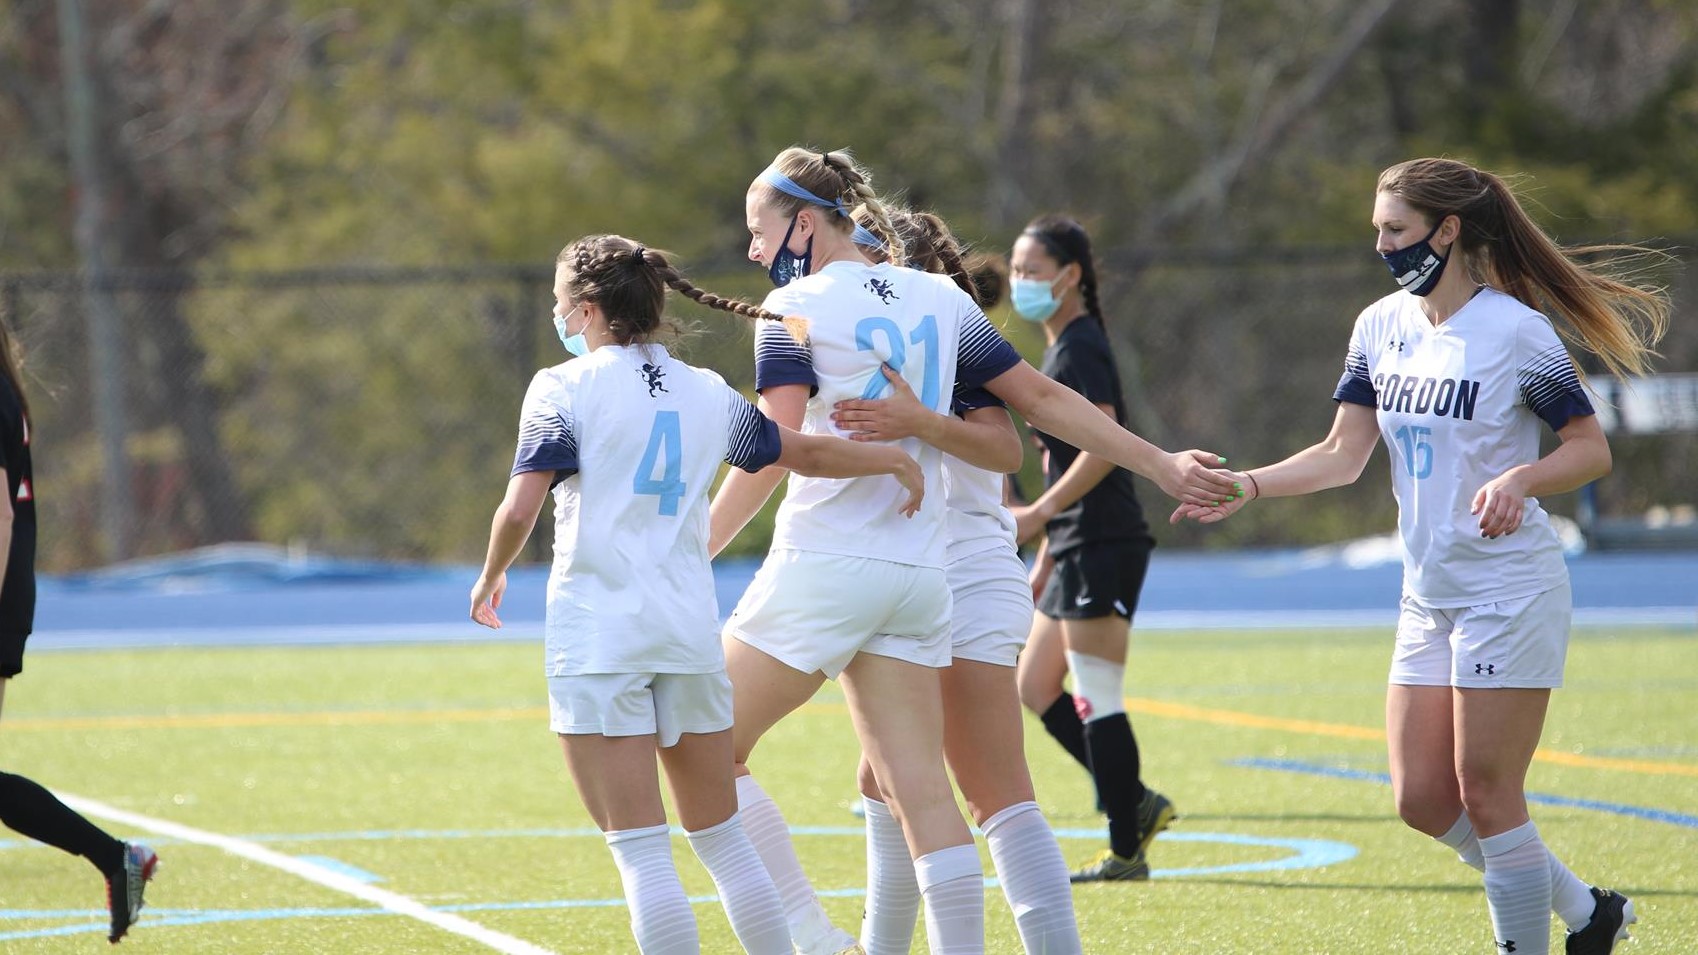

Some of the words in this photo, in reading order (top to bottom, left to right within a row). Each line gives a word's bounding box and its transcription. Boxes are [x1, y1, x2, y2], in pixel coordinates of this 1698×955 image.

[855, 315, 940, 412] 21
[1374, 372, 1480, 421] GORDON
[633, 410, 687, 516] 4
[1395, 425, 1434, 480] 15
